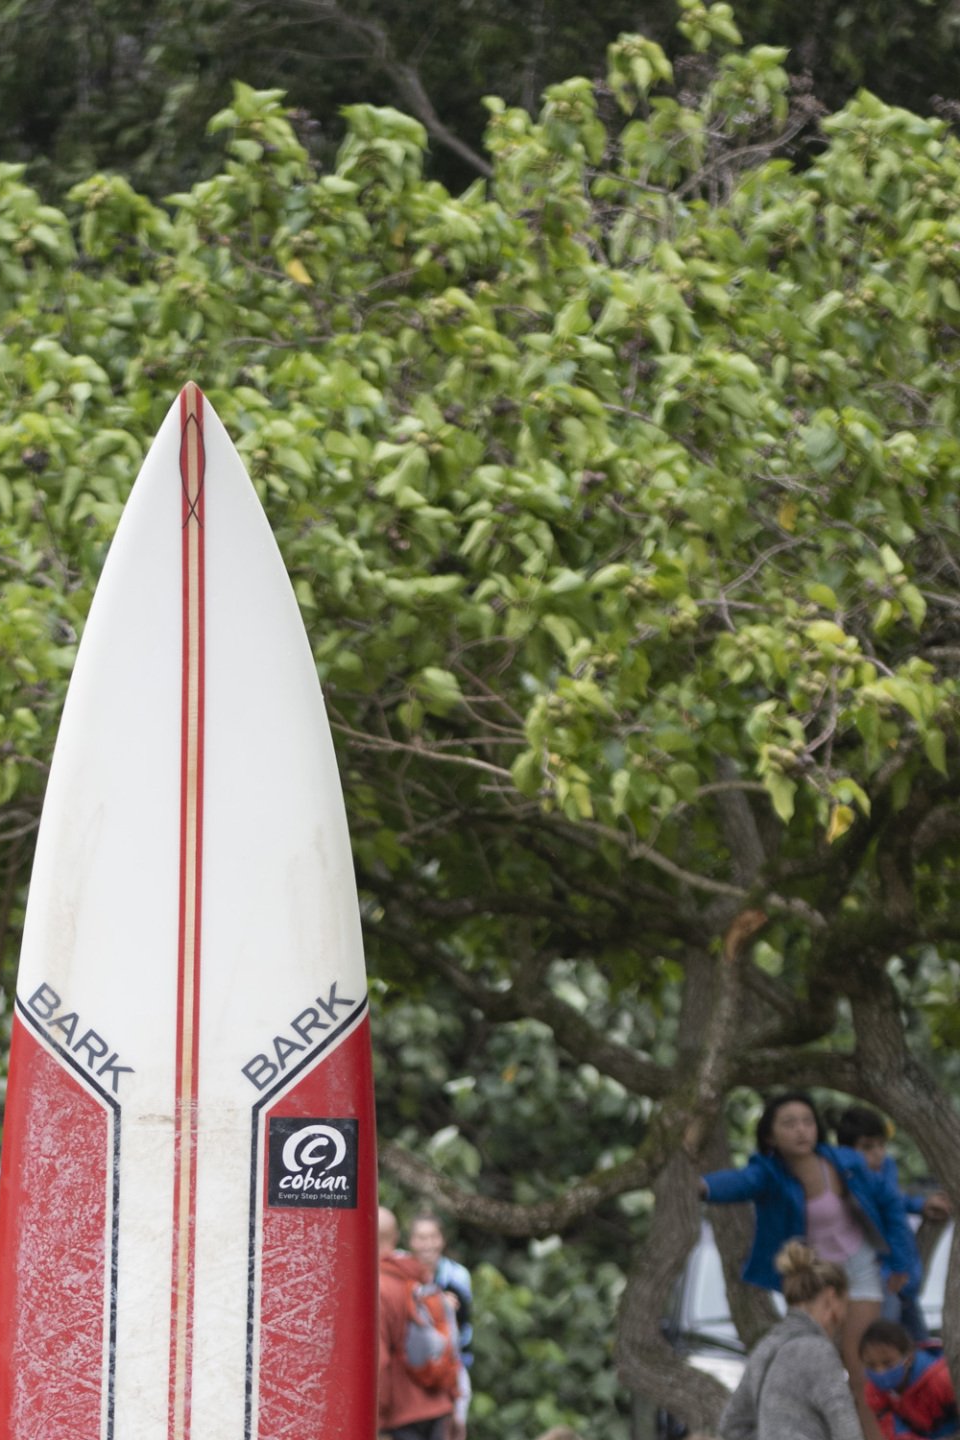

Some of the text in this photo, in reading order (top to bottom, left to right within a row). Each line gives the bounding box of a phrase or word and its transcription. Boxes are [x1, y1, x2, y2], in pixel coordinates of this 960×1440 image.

[27, 982, 136, 1094] BARK
[241, 980, 356, 1091] BARK
[278, 1167, 348, 1192] cobian
[278, 1192, 348, 1200] Every Step Matters
